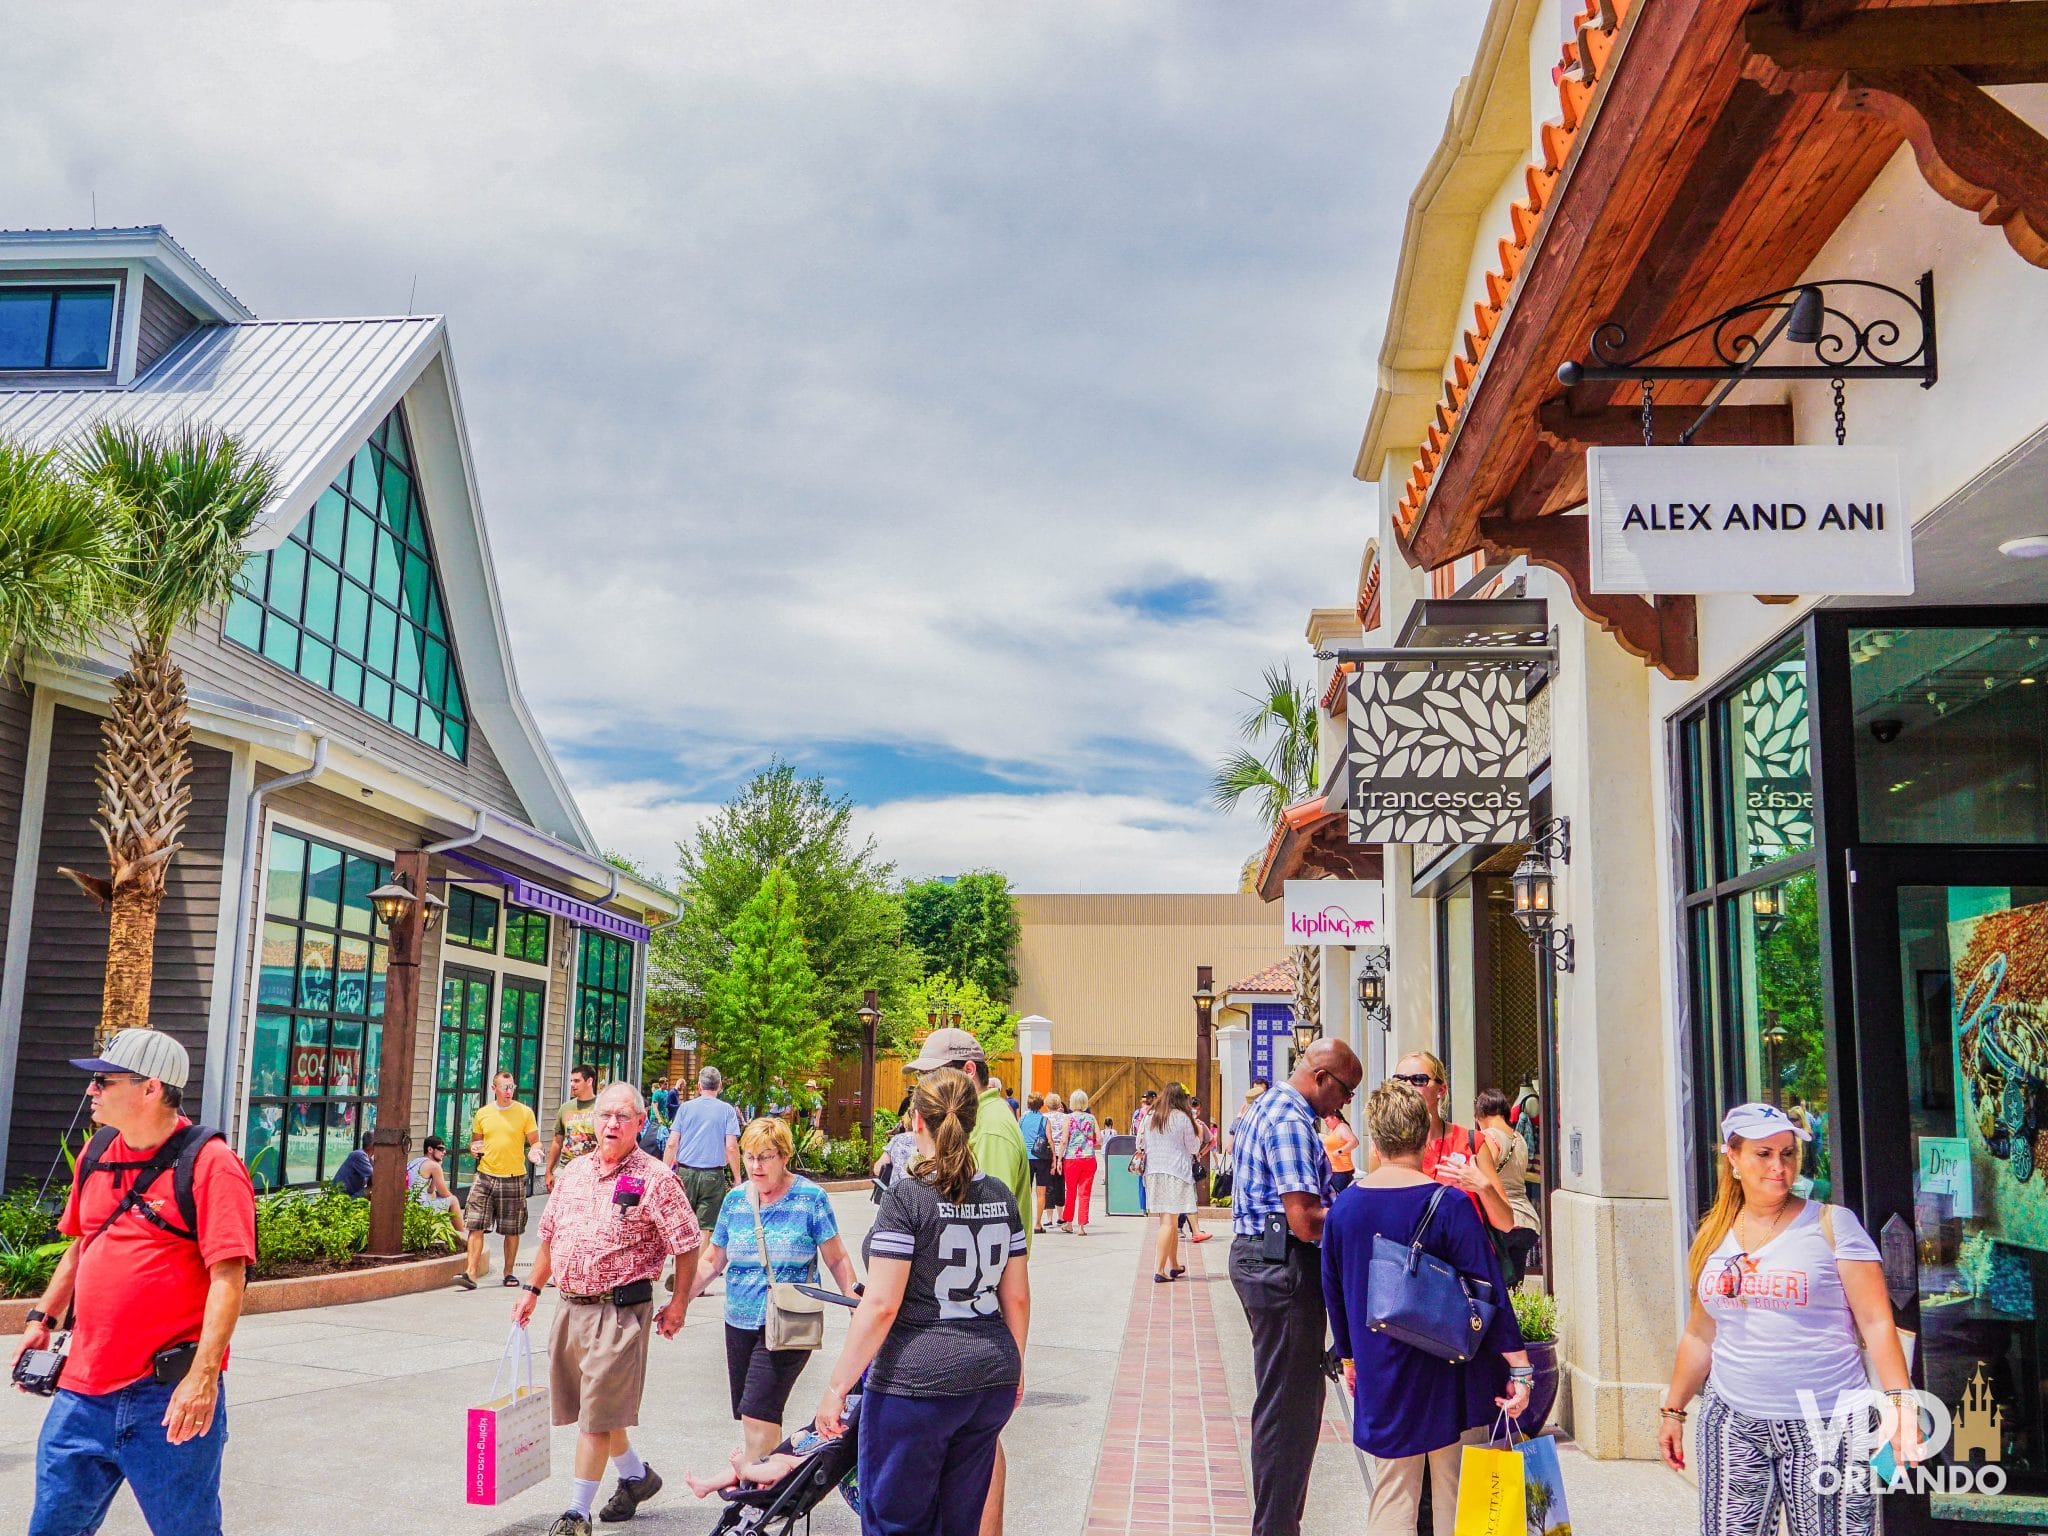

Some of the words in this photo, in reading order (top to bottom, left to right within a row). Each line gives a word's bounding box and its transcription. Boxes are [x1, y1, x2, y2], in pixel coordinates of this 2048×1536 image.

[1622, 503, 1713, 531] ALEX
[1723, 503, 1807, 531] AND
[1818, 503, 1885, 531] ANI
[1356, 779, 1522, 809] francesca's
[1929, 1148, 1959, 1177] Dive
[934, 1222, 1012, 1320] 28
[1754, 1298, 1790, 1310] BODY
[477, 1417, 489, 1497] kipling-usa.com
